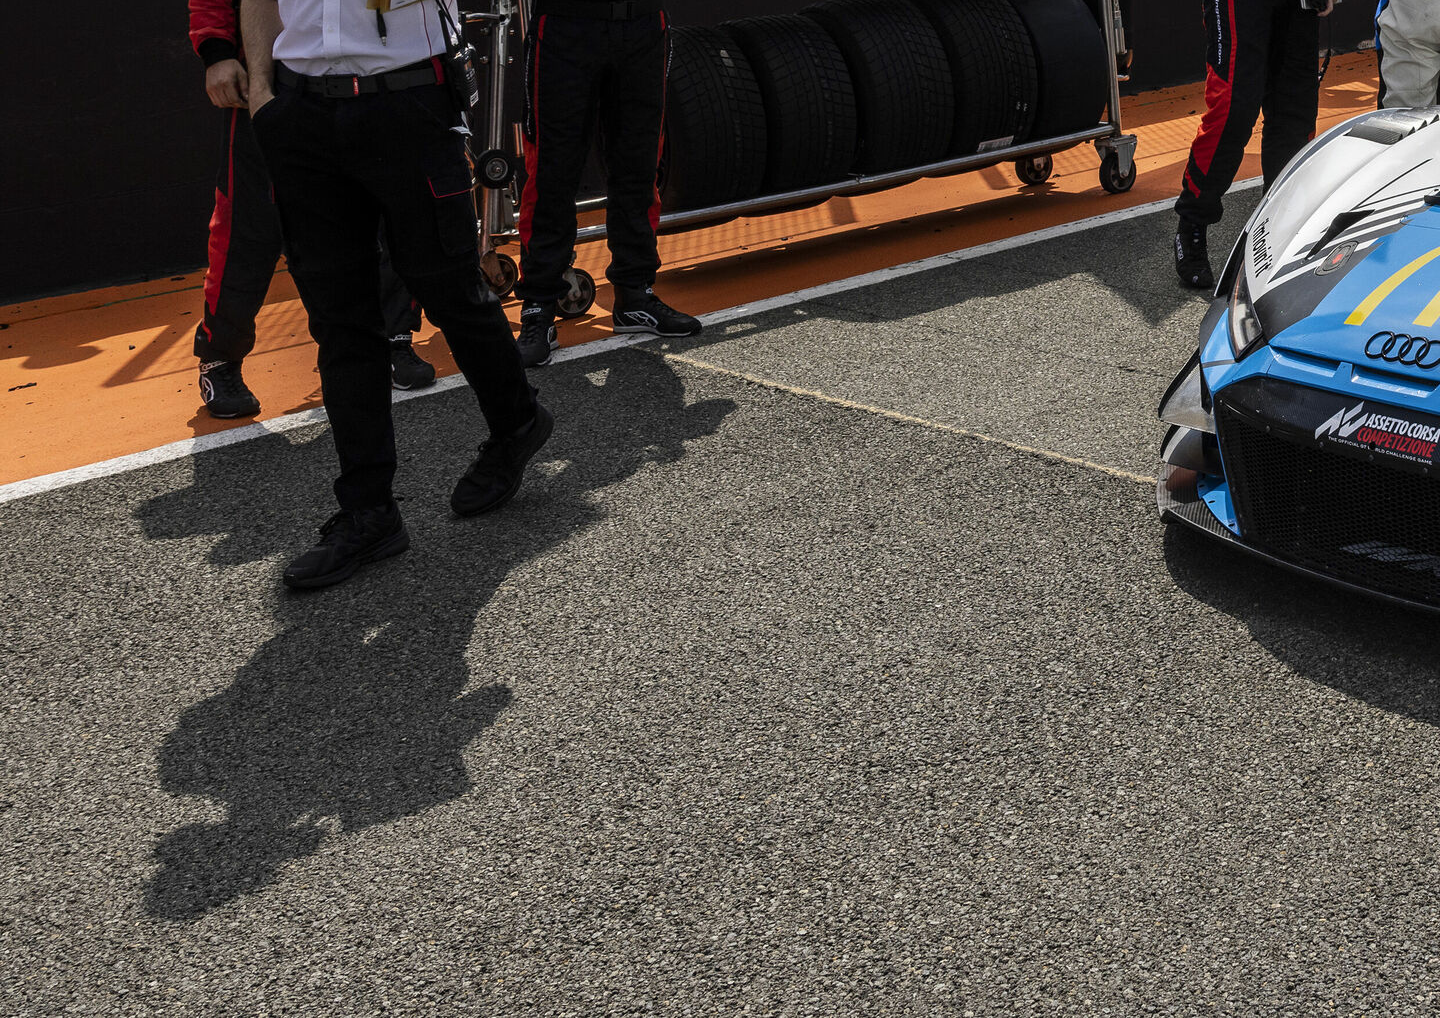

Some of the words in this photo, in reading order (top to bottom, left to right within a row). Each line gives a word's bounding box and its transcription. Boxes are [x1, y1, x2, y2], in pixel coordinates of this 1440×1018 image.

[1365, 413, 1409, 433] ASSETTO
[1338, 438, 1360, 448] OFFICIAL
[1386, 450, 1417, 462] CHALLENGE
[1417, 457, 1433, 465] GAME
[1357, 428, 1437, 458] COMPETIZIONE
